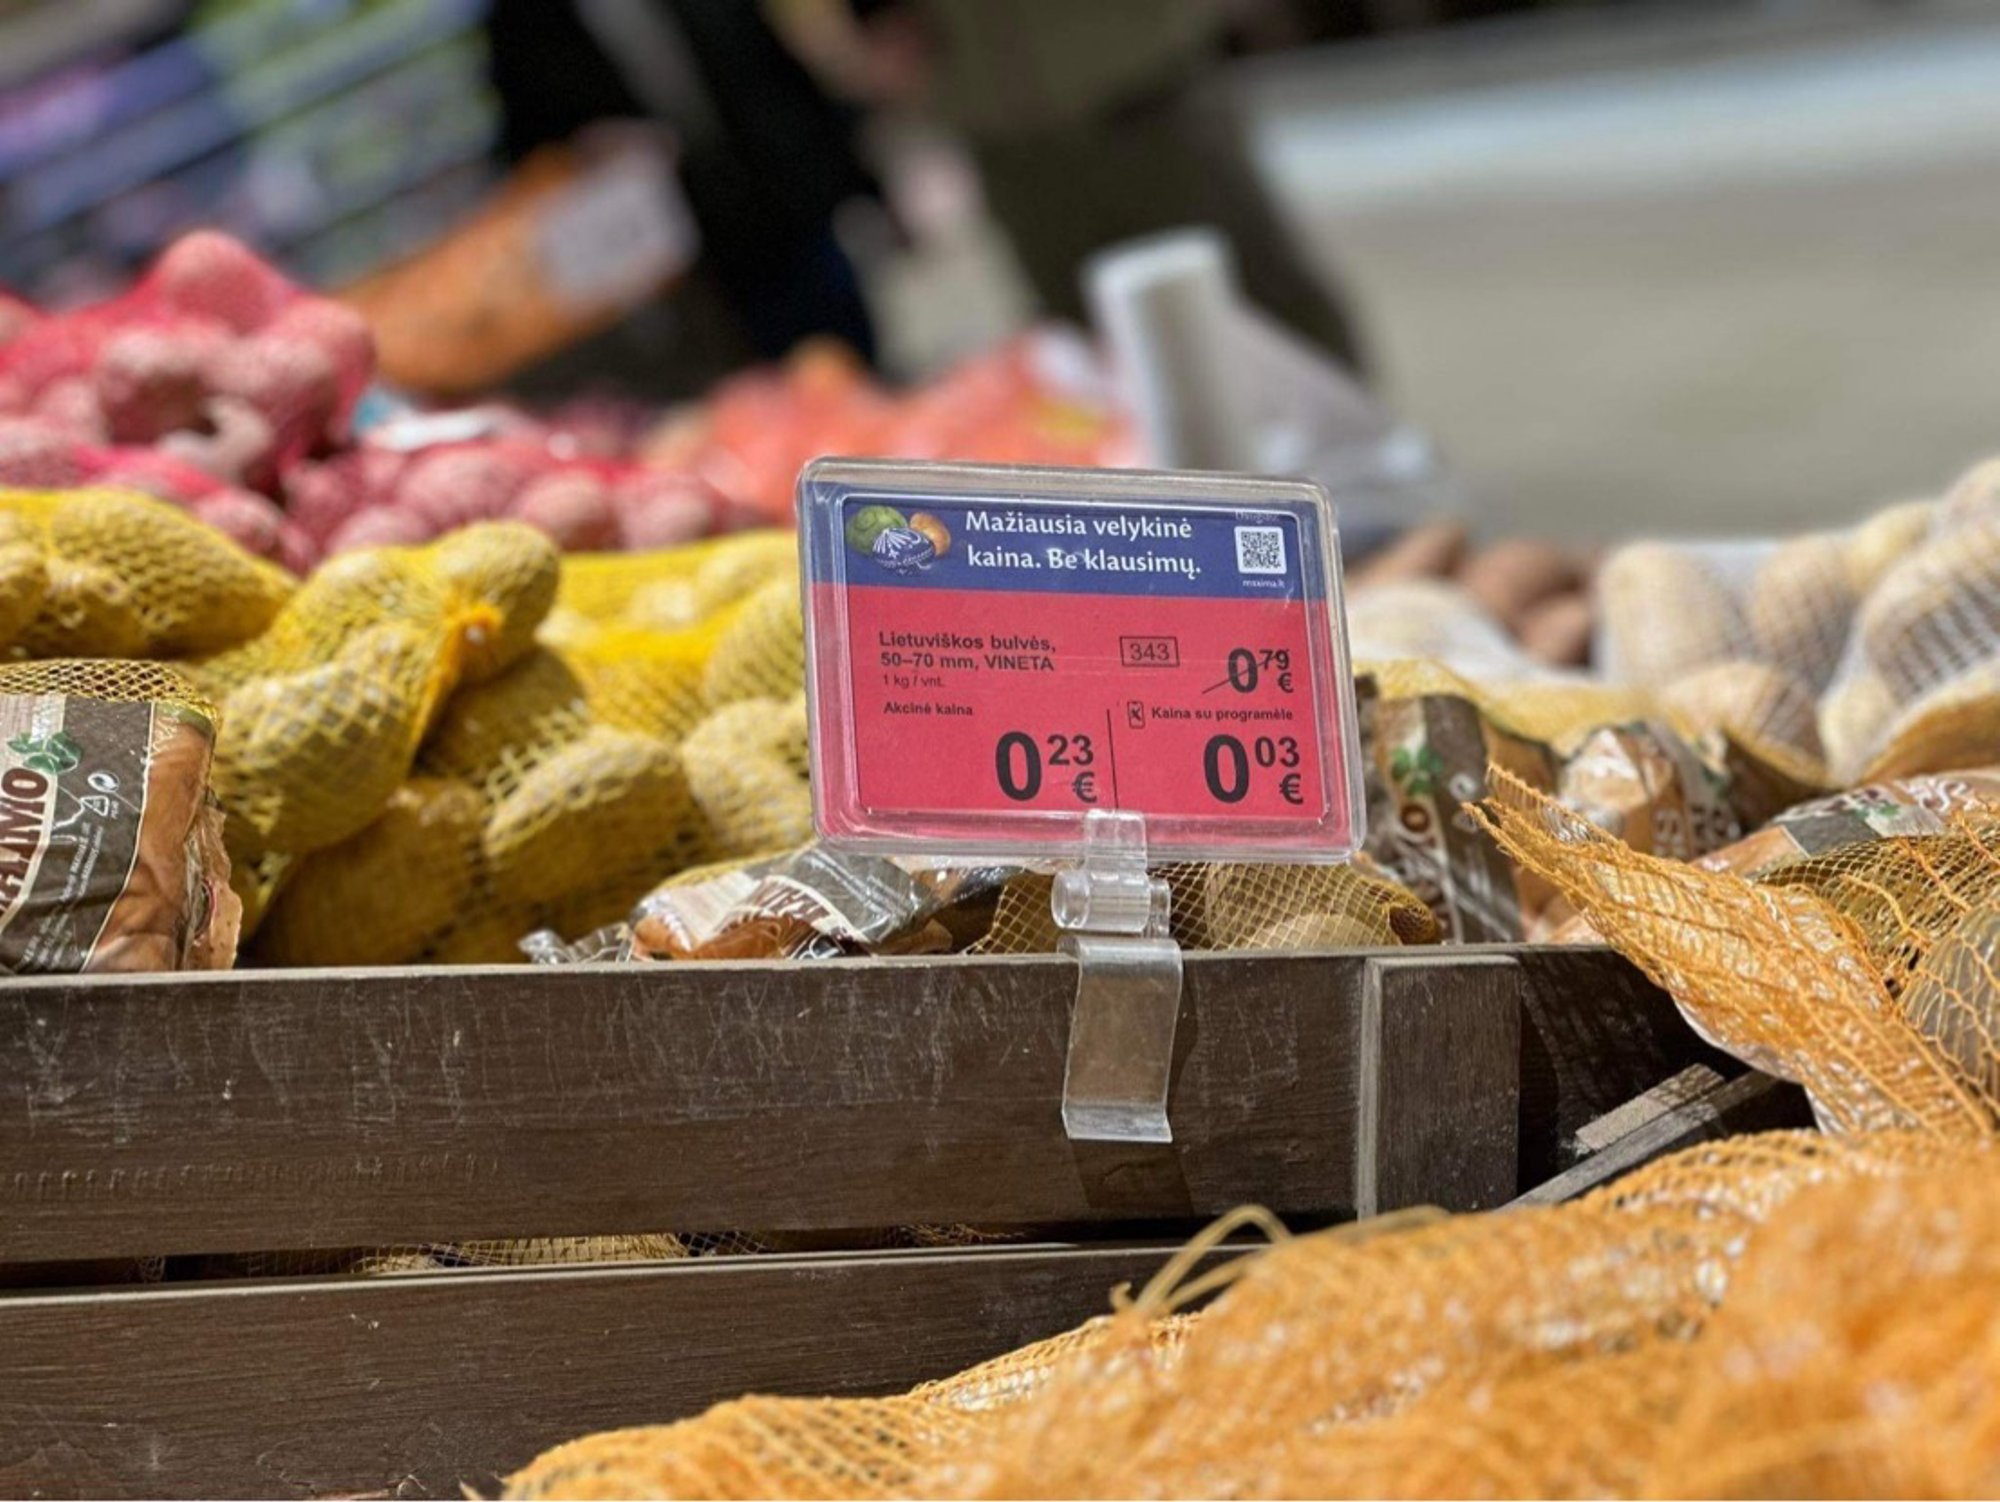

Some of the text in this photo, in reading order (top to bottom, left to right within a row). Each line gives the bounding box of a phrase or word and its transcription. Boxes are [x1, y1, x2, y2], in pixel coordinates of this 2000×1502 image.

[965, 511, 1192, 542] Mažiausia velykinė
[967, 544, 1201, 581] kaina. Be klausimų.
[879, 631, 1056, 653] Lietuviškos bulvės,
[1130, 643, 1169, 661] 343
[940, 656, 979, 671] mm,
[984, 654, 1055, 671] VINETA
[884, 674, 888, 685] 1
[894, 675, 910, 689] kg
[921, 676, 944, 687] vnt.
[884, 702, 973, 715] Akcinė kaina
[1152, 707, 1293, 723] Kaina su programėle
